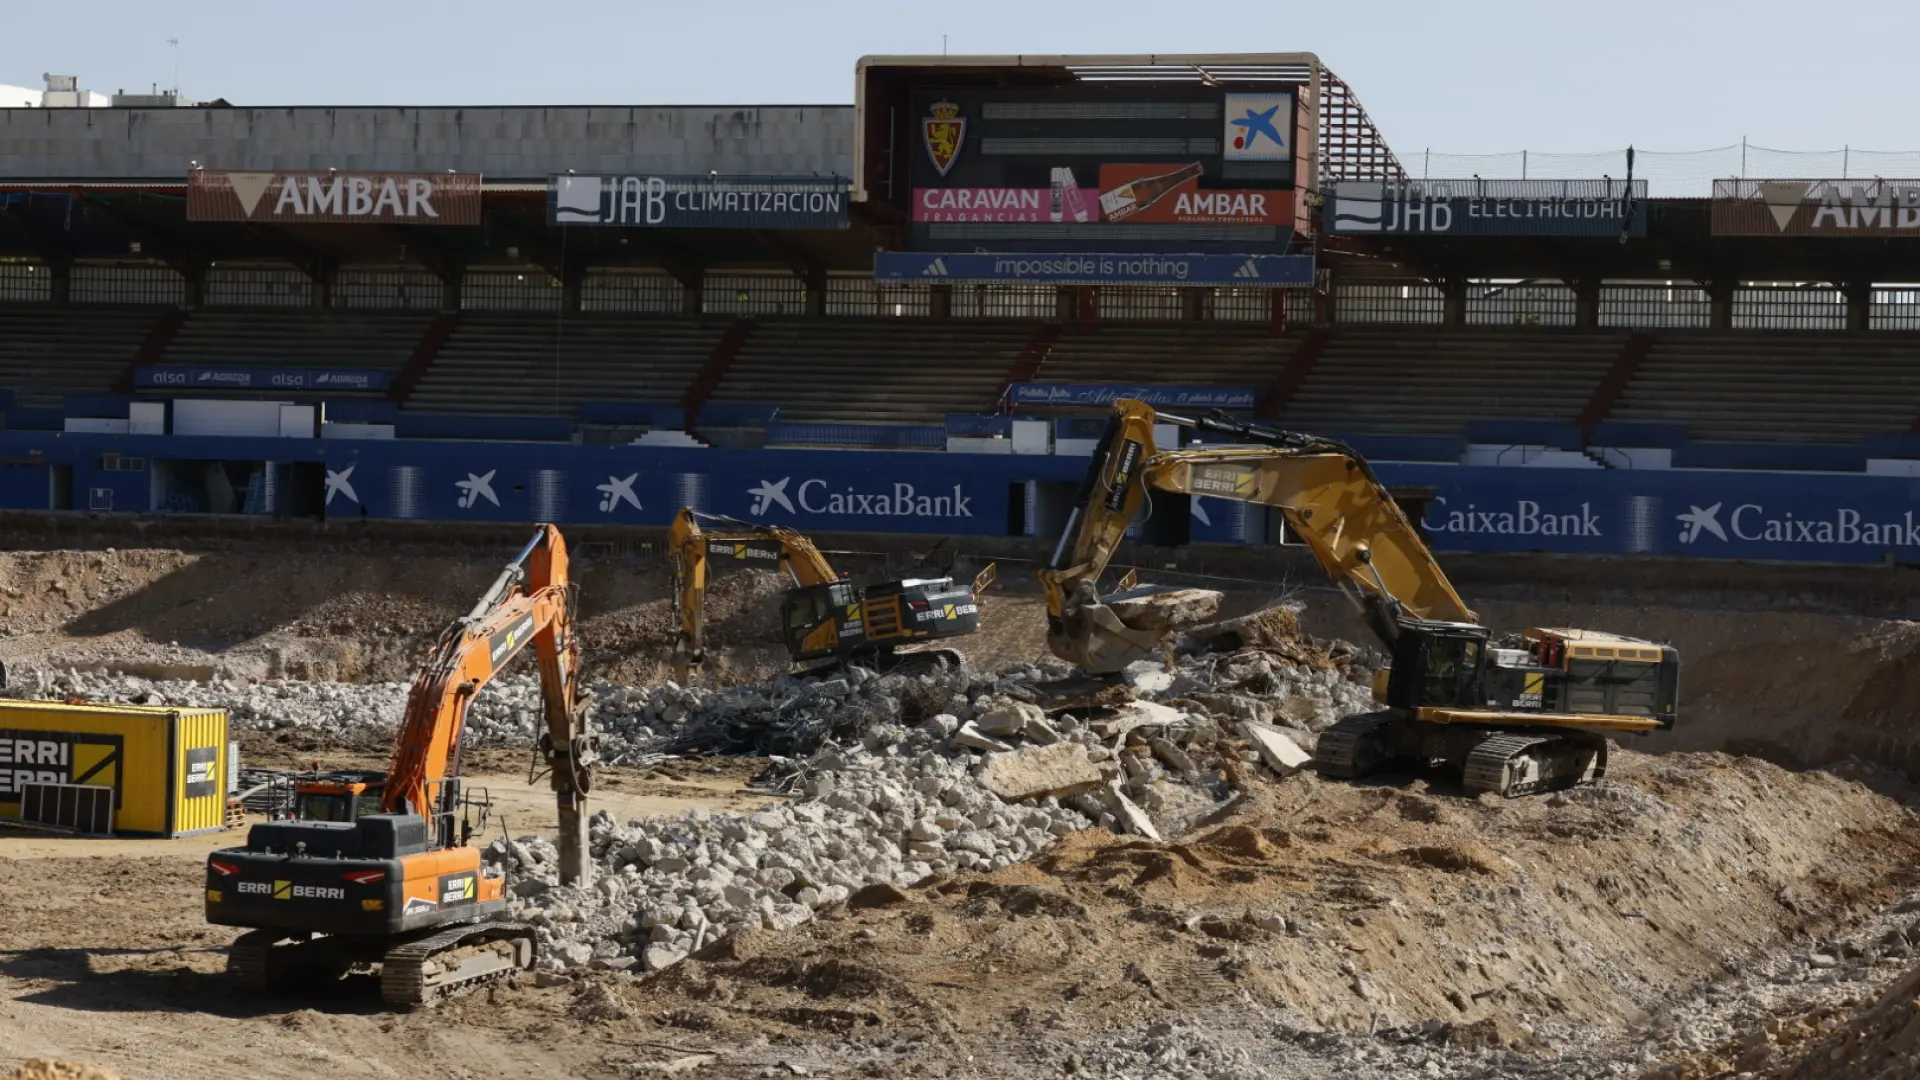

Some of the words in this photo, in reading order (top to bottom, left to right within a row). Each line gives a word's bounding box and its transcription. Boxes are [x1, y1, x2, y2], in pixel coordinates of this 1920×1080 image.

[274, 177, 439, 217] AMBAR
[604, 177, 666, 224] JAB
[923, 189, 1039, 209] CARAVAN
[1173, 193, 1267, 216] AMBAR
[924, 213, 1038, 222] FRAGANCIAS
[995, 256, 1095, 277] impossible
[1099, 257, 1114, 274] is
[1118, 258, 1189, 279] nothing
[153, 373, 186, 384] alsa
[271, 374, 304, 386] alsa
[1204, 469, 1236, 481] ERRI
[1194, 480, 1236, 492] BERRI
[798, 479, 973, 517] CaixaBank
[1420, 496, 1602, 536] CaixaBank
[1731, 504, 1920, 546] CaixaBank
[710, 544, 734, 555] ERRI
[747, 548, 777, 560] BERRI
[916, 609, 944, 622] ERRI
[0, 739, 68, 766] ERRI
[237, 881, 272, 894] ERRI
[292, 885, 345, 900] BERRI
[447, 879, 463, 890] ERRI
[443, 890, 463, 903] BERRI
